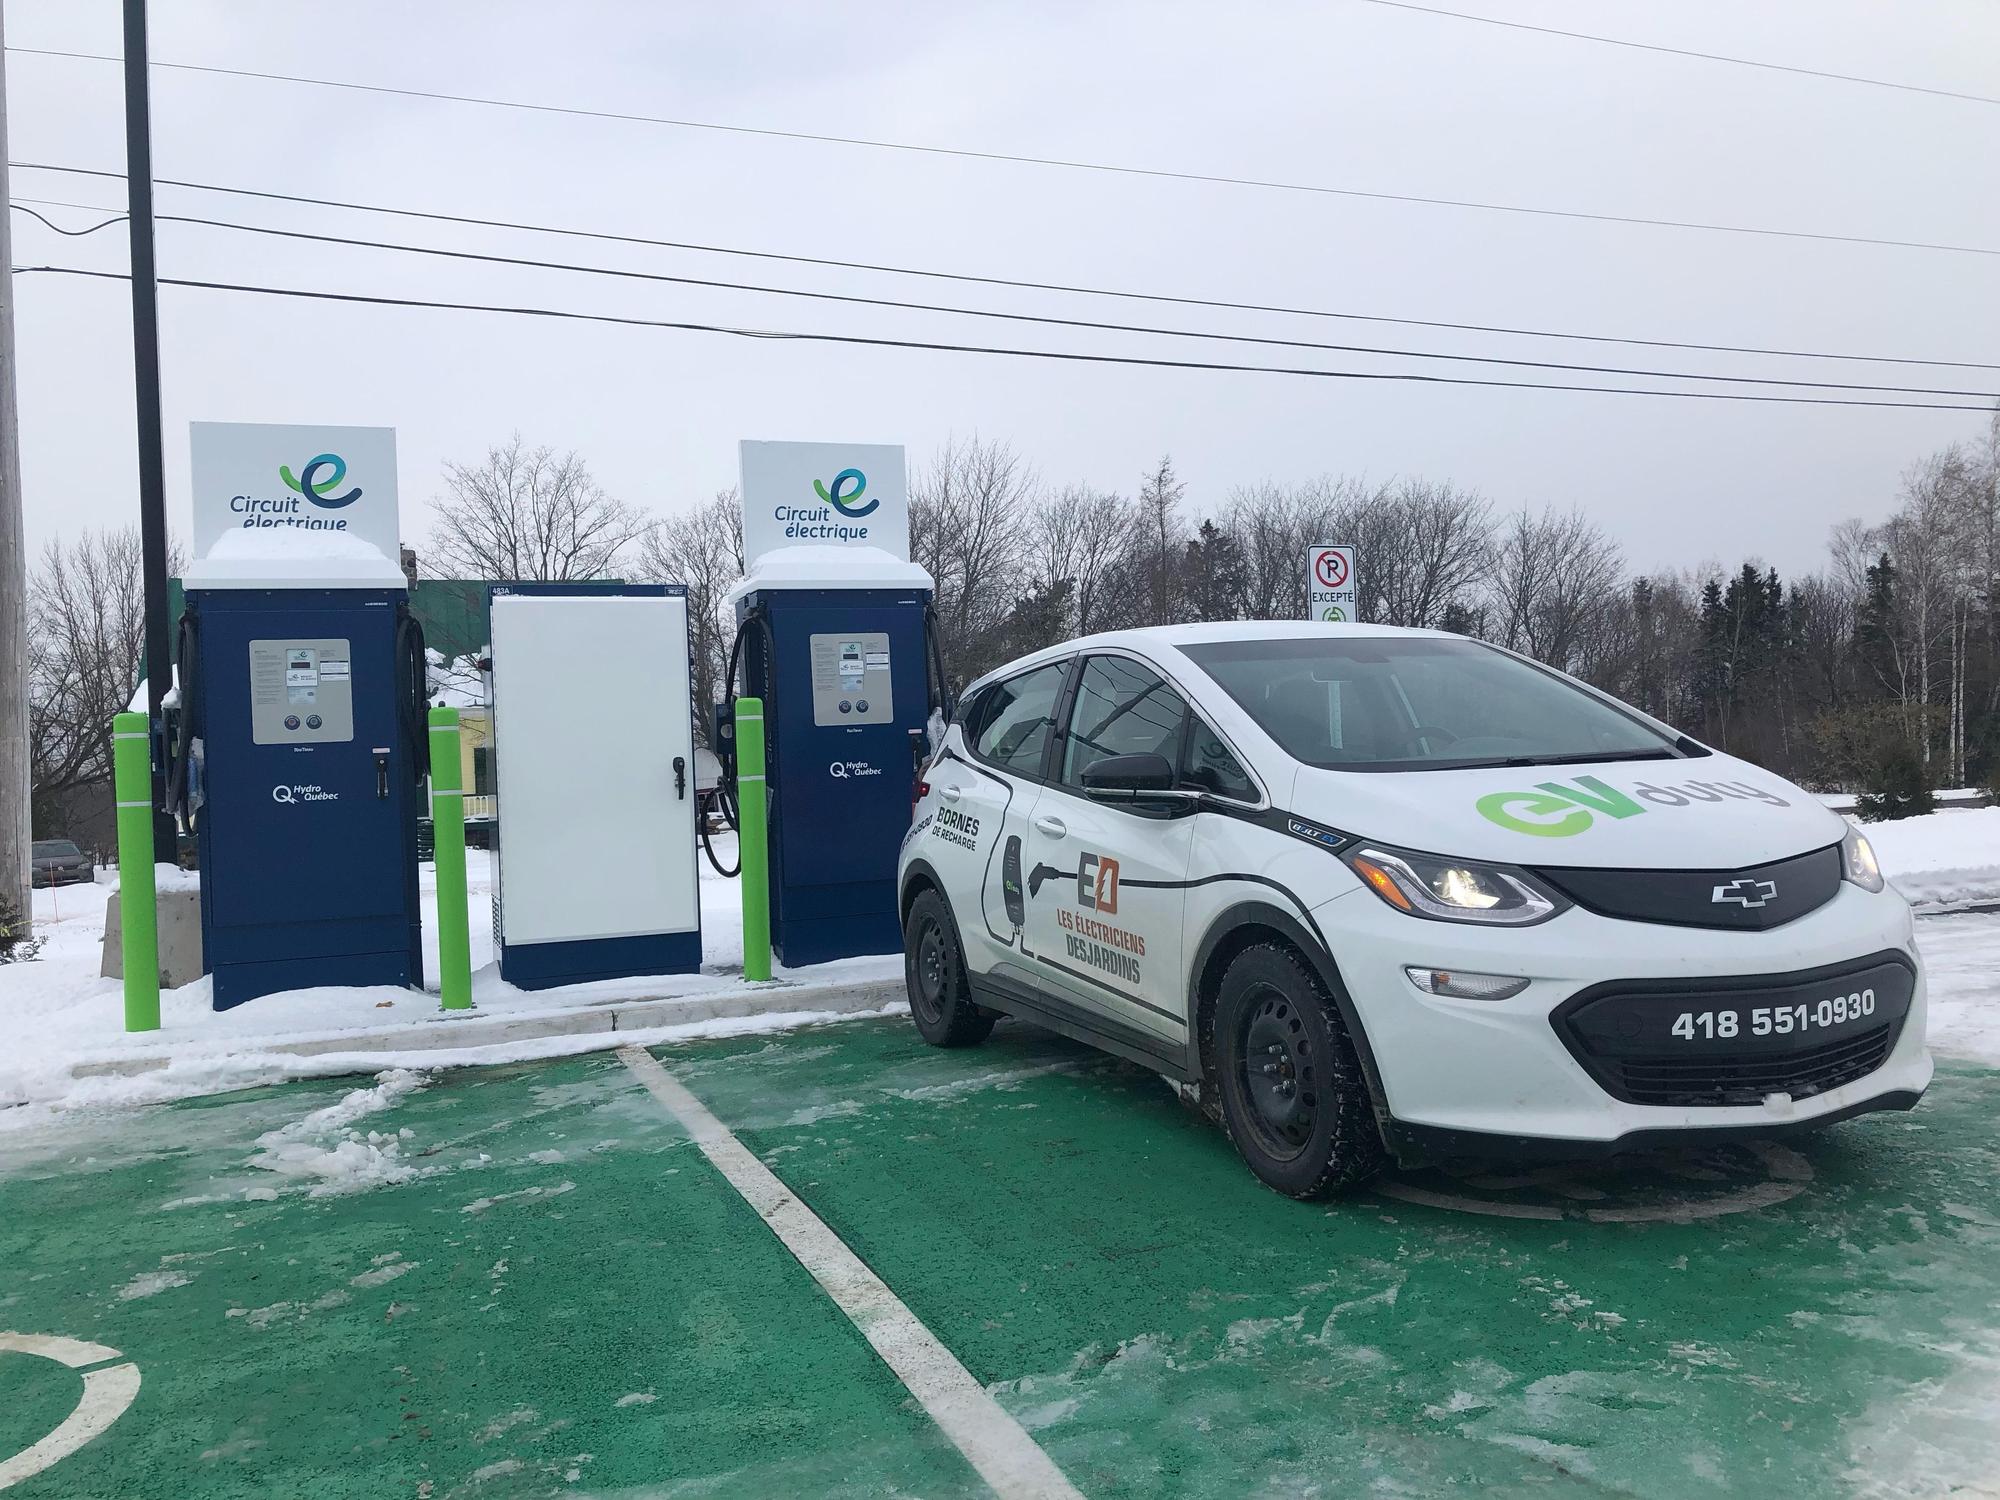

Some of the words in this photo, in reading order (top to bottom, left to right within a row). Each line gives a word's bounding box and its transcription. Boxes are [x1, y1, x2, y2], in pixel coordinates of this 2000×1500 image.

[229, 495, 300, 513] Circuit
[774, 505, 830, 522] Circuit
[785, 522, 868, 543] électrique
[1312, 590, 1354, 602] EXCEPTÉ
[846, 761, 868, 770] Hydro
[854, 767, 882, 776] Québec
[294, 784, 321, 795] Hydro
[304, 791, 339, 801] Québec
[937, 806, 980, 837] BORNES
[932, 825, 941, 837] DE
[940, 828, 976, 852] RECHARGE
[1056, 908, 1073, 931] LES
[1075, 911, 1145, 956] ÉLECTRICIENS
[1065, 933, 1141, 984] DESJARDINS
[1671, 1010, 1739, 1040] 418
[1752, 988, 1875, 1036] 551-0930
